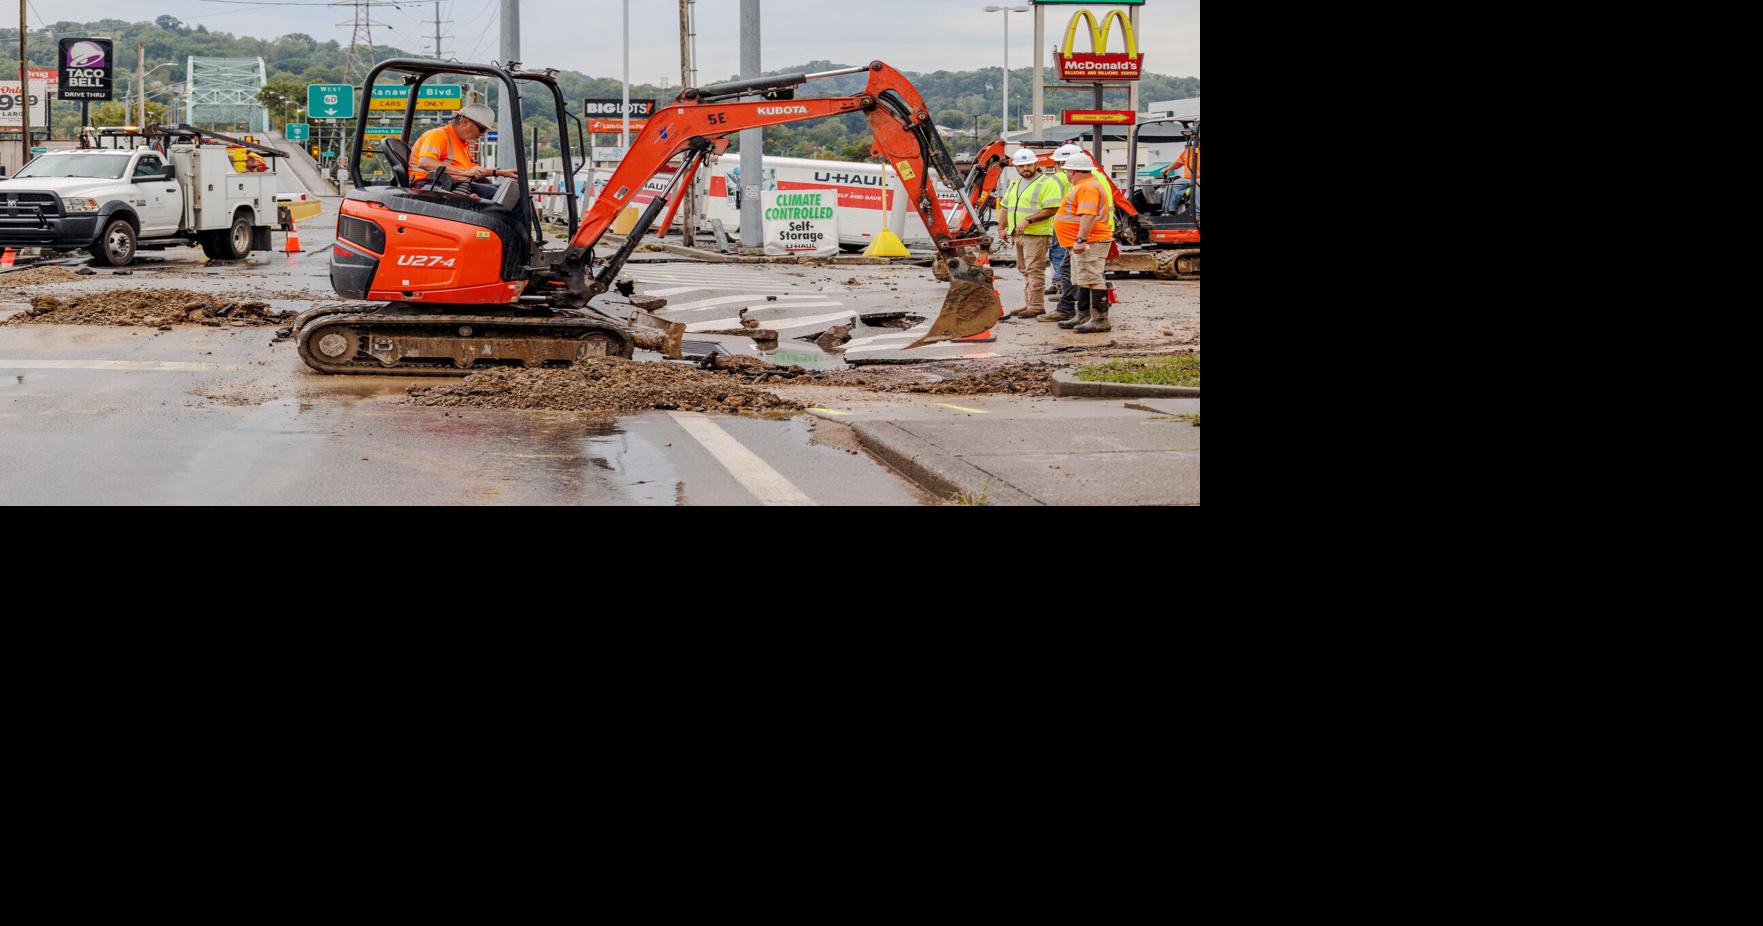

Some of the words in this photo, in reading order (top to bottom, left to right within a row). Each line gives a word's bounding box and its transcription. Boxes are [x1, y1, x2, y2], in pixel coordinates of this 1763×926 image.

[1064, 61, 1137, 70] McDonald's
[66, 68, 104, 78] TACO
[69, 78, 104, 87] BELL
[1, 86, 24, 94] Onl
[372, 88, 421, 96] Kanaw
[426, 88, 454, 96] Blvd.
[325, 96, 337, 104] 60
[586, 103, 616, 114] BIG
[757, 105, 808, 115] KUBOTA
[814, 171, 889, 187] U-HAUL
[776, 193, 821, 206] CLIMATE
[765, 206, 833, 220] CONTROLLED
[789, 221, 814, 231] Self-
[780, 230, 824, 242] Storage
[397, 254, 456, 267] U27-4
